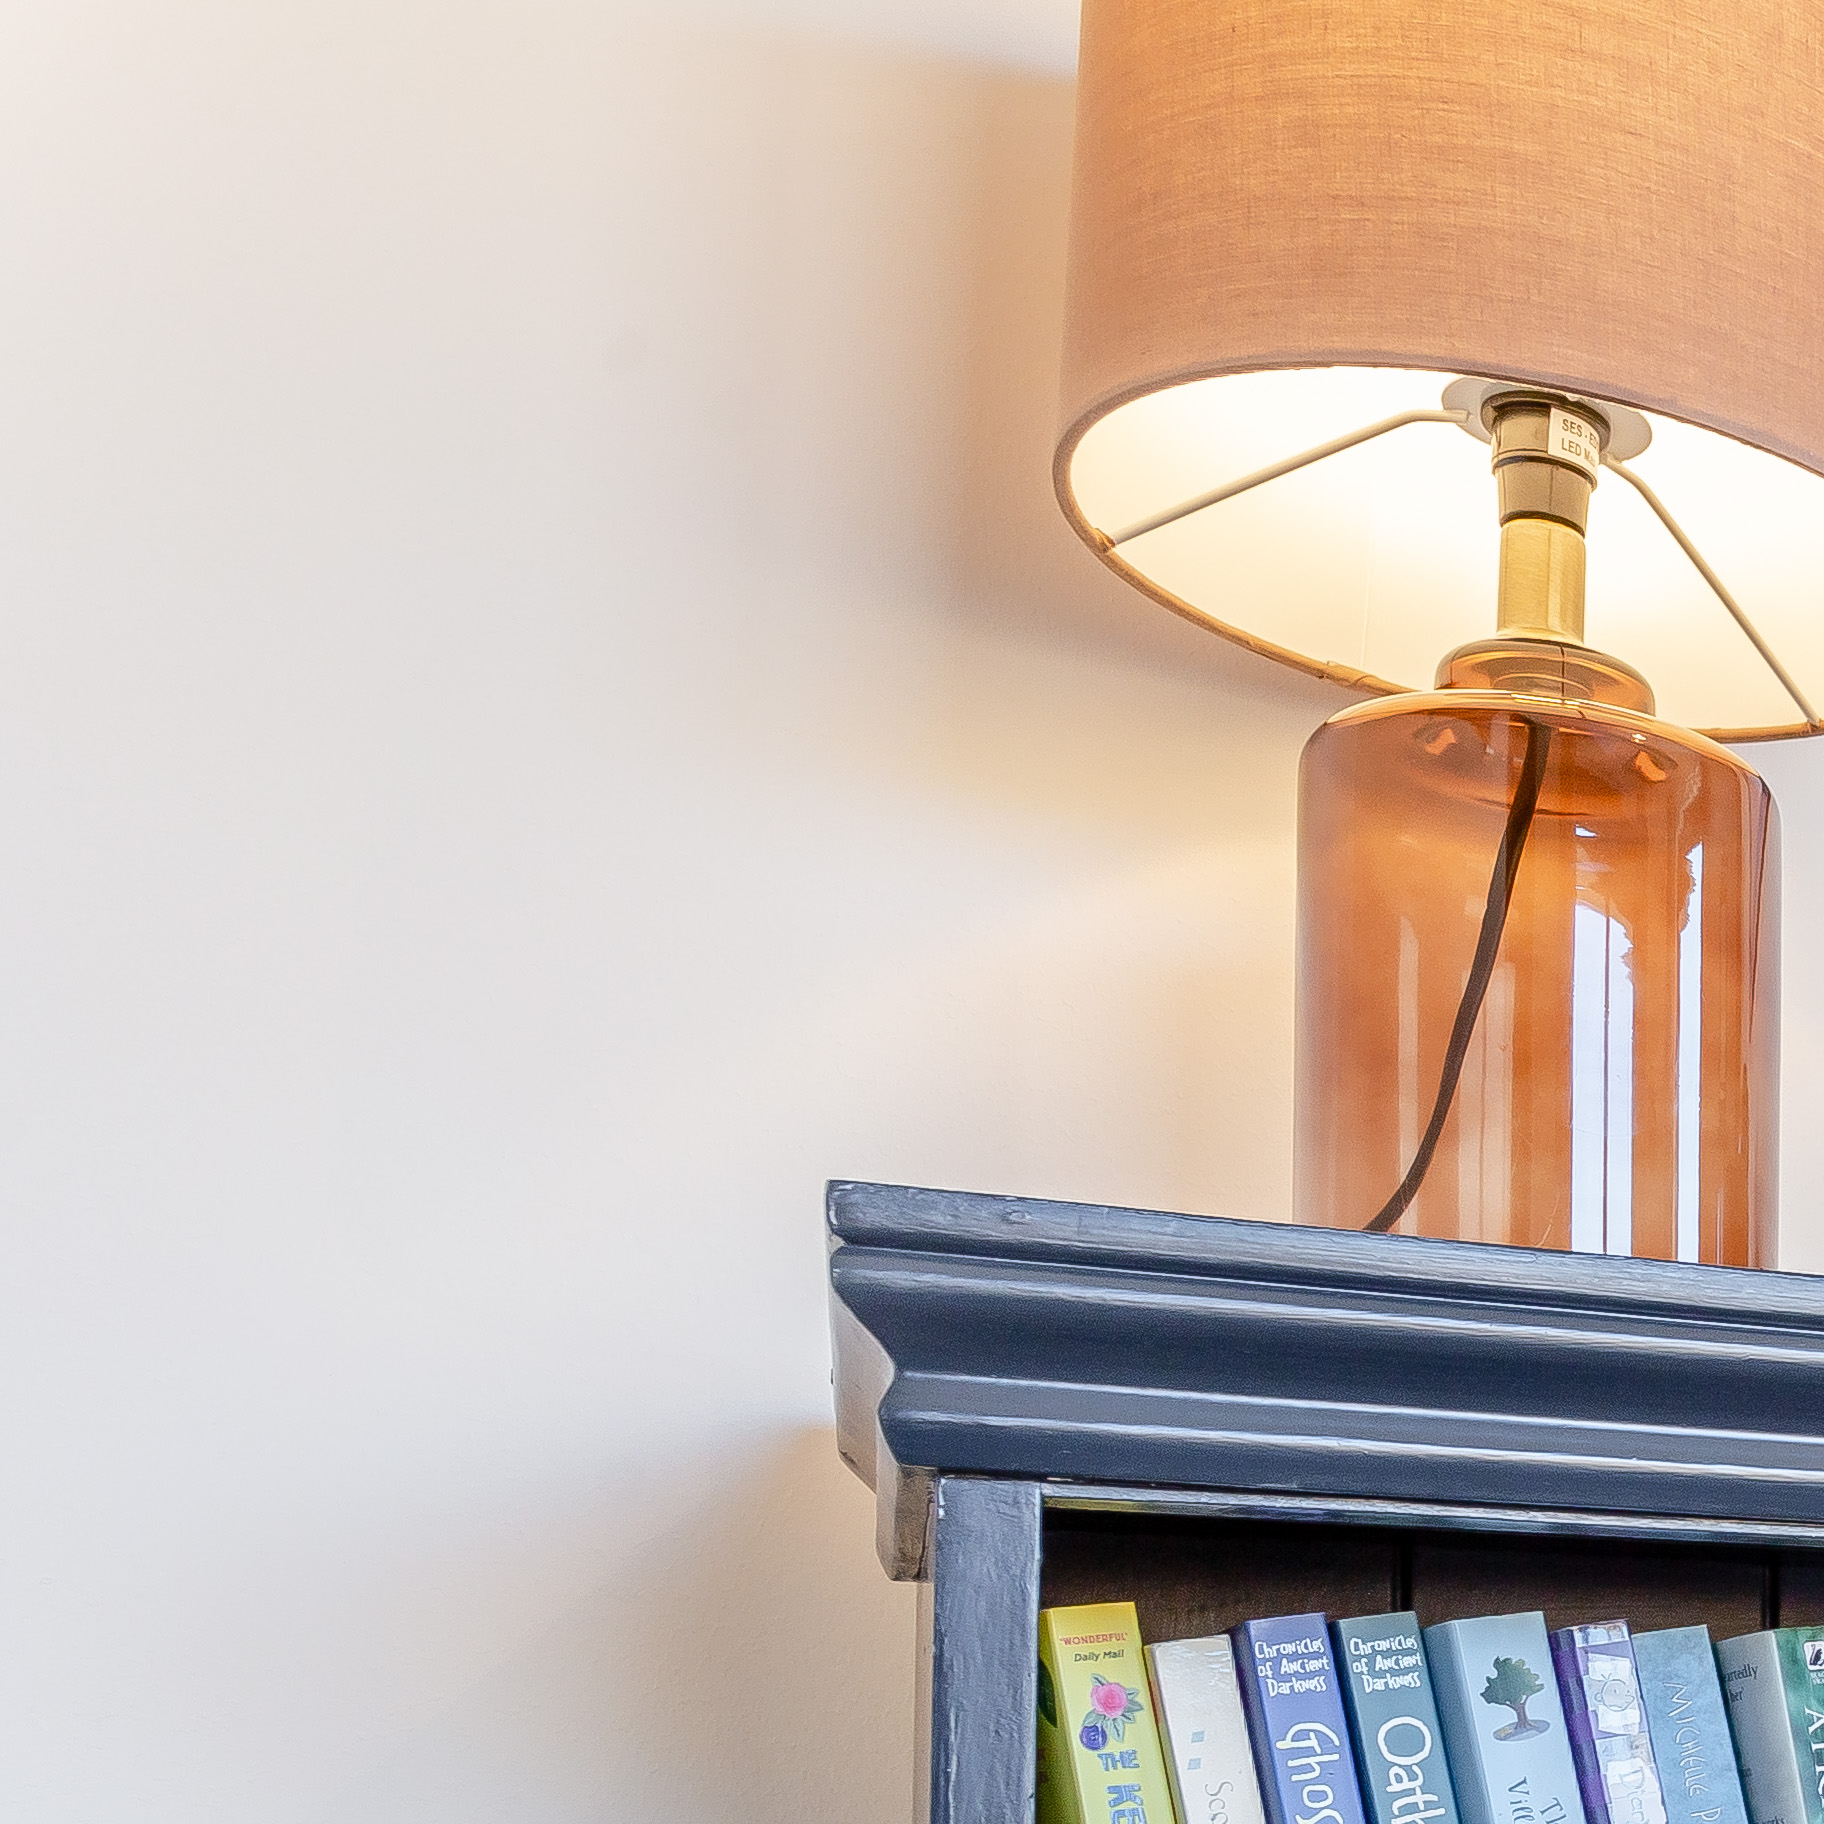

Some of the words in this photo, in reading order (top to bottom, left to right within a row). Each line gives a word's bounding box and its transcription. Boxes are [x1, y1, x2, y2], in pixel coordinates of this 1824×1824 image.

[1561, 418, 1583, 438] SES
[1561, 437, 1582, 457] LED
[1074, 1653, 1100, 1662] Daily
[1103, 1649, 1124, 1659] Mail
[1257, 1662, 1274, 1679] of
[1352, 1658, 1371, 1676] of
[1663, 1680, 1710, 1798] MICHELLE
[1097, 1750, 1141, 1771] THE
